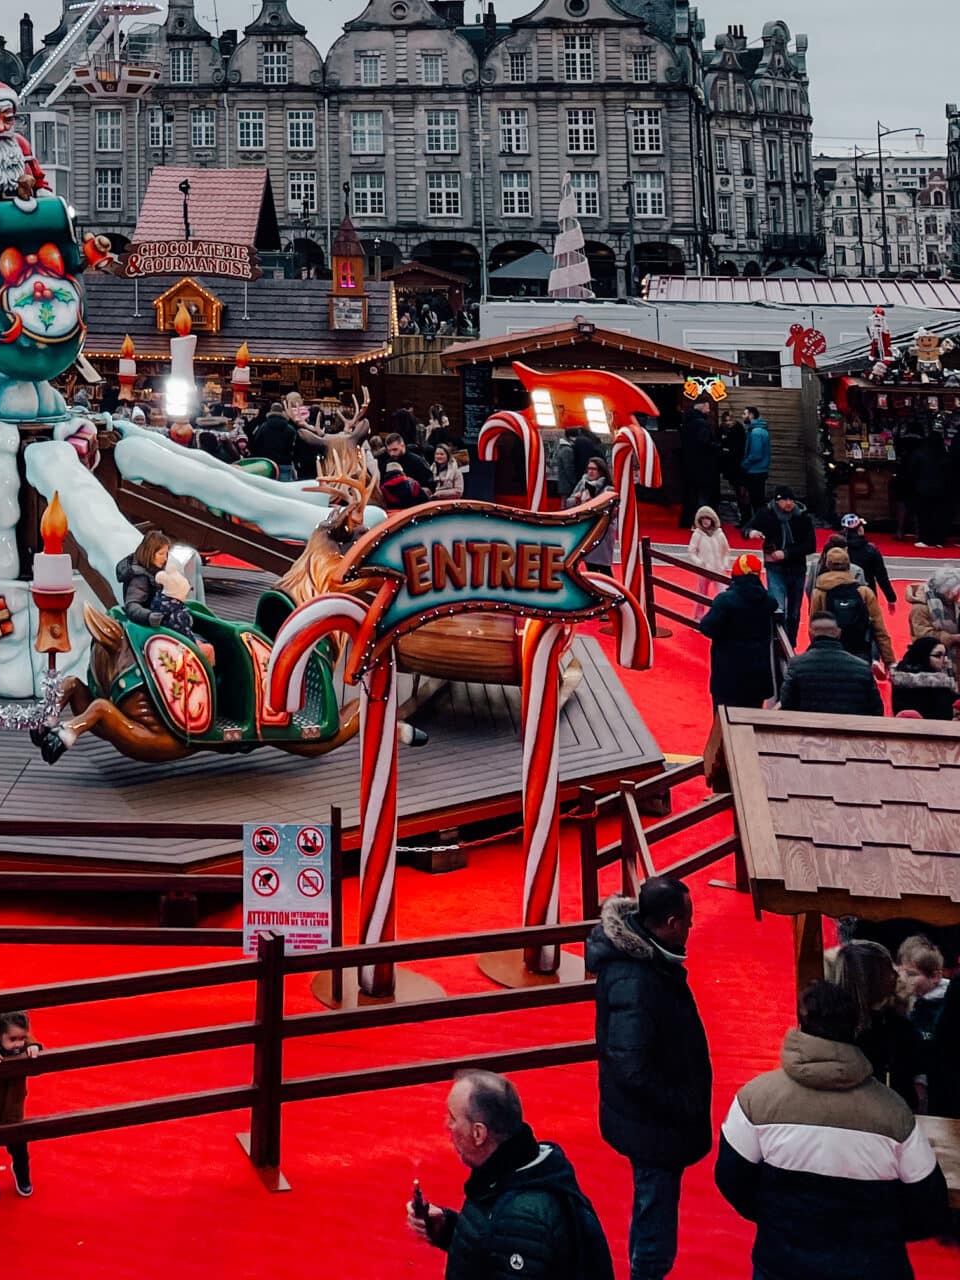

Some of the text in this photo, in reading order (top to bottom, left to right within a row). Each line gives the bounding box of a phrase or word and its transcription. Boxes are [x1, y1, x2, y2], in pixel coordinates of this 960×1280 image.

[138, 241, 249, 261] CHOCOLATERIE
[143, 257, 251, 278] GOURMANDISE
[402, 539, 566, 596] ENTREE
[247, 910, 290, 926] ATTENTION
